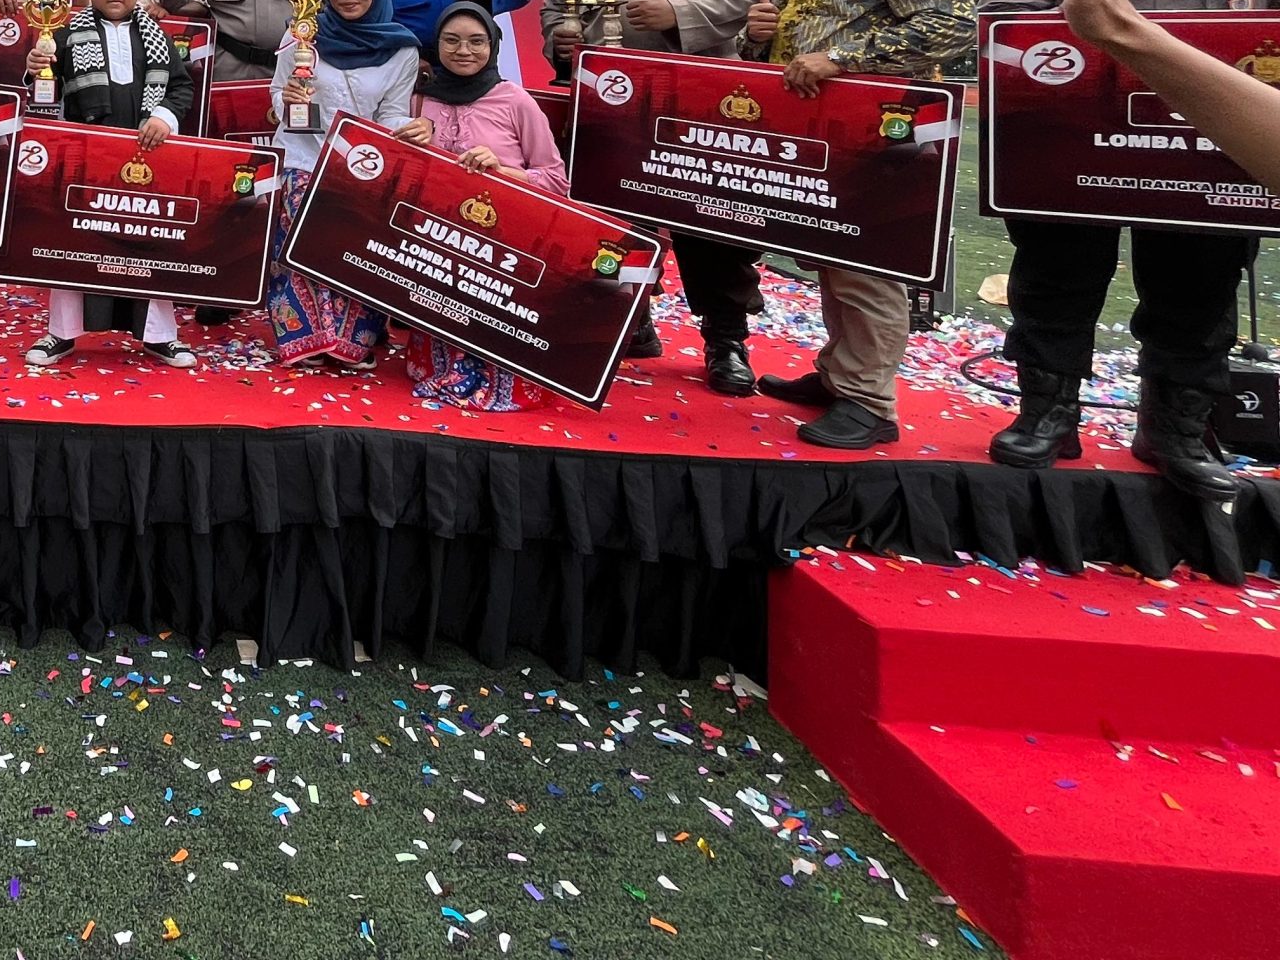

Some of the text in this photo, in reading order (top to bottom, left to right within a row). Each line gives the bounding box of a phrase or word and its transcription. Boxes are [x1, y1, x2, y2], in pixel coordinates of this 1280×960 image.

[679, 126, 798, 160] JUARA 3
[1093, 132, 1221, 152] LOMBA B
[641, 161, 838, 209] WILAYAH AGLOMERASI
[650, 150, 829, 192] LOMBA SATKAMLING
[1077, 174, 1136, 189] DALAM
[1140, 178, 1213, 193] RANGKA
[1216, 183, 1264, 197] HARI
[89, 192, 175, 217] JUARA 1
[621, 179, 860, 237] DALAM RANGKA HARI BHAYANGKARA KE-78
[695, 204, 765, 227] TAHUN 2024
[1205, 193, 1269, 209] TAHUN
[73, 217, 186, 240] LOMBA DAI CILIK
[414, 216, 519, 273] JUARA 2
[32, 247, 217, 275] DALAM RANGKA HARI BHAYANGKARA KE-78
[97, 263, 151, 278] TAHUN 2024
[400, 239, 515, 297] LOMBA TARIAN
[366, 238, 540, 325] NUSANTARA GEMILANG
[343, 251, 549, 351] DALAM RANGKA HARI BHAYANGKARA KE-78
[408, 291, 470, 325] TAHUN 2024
